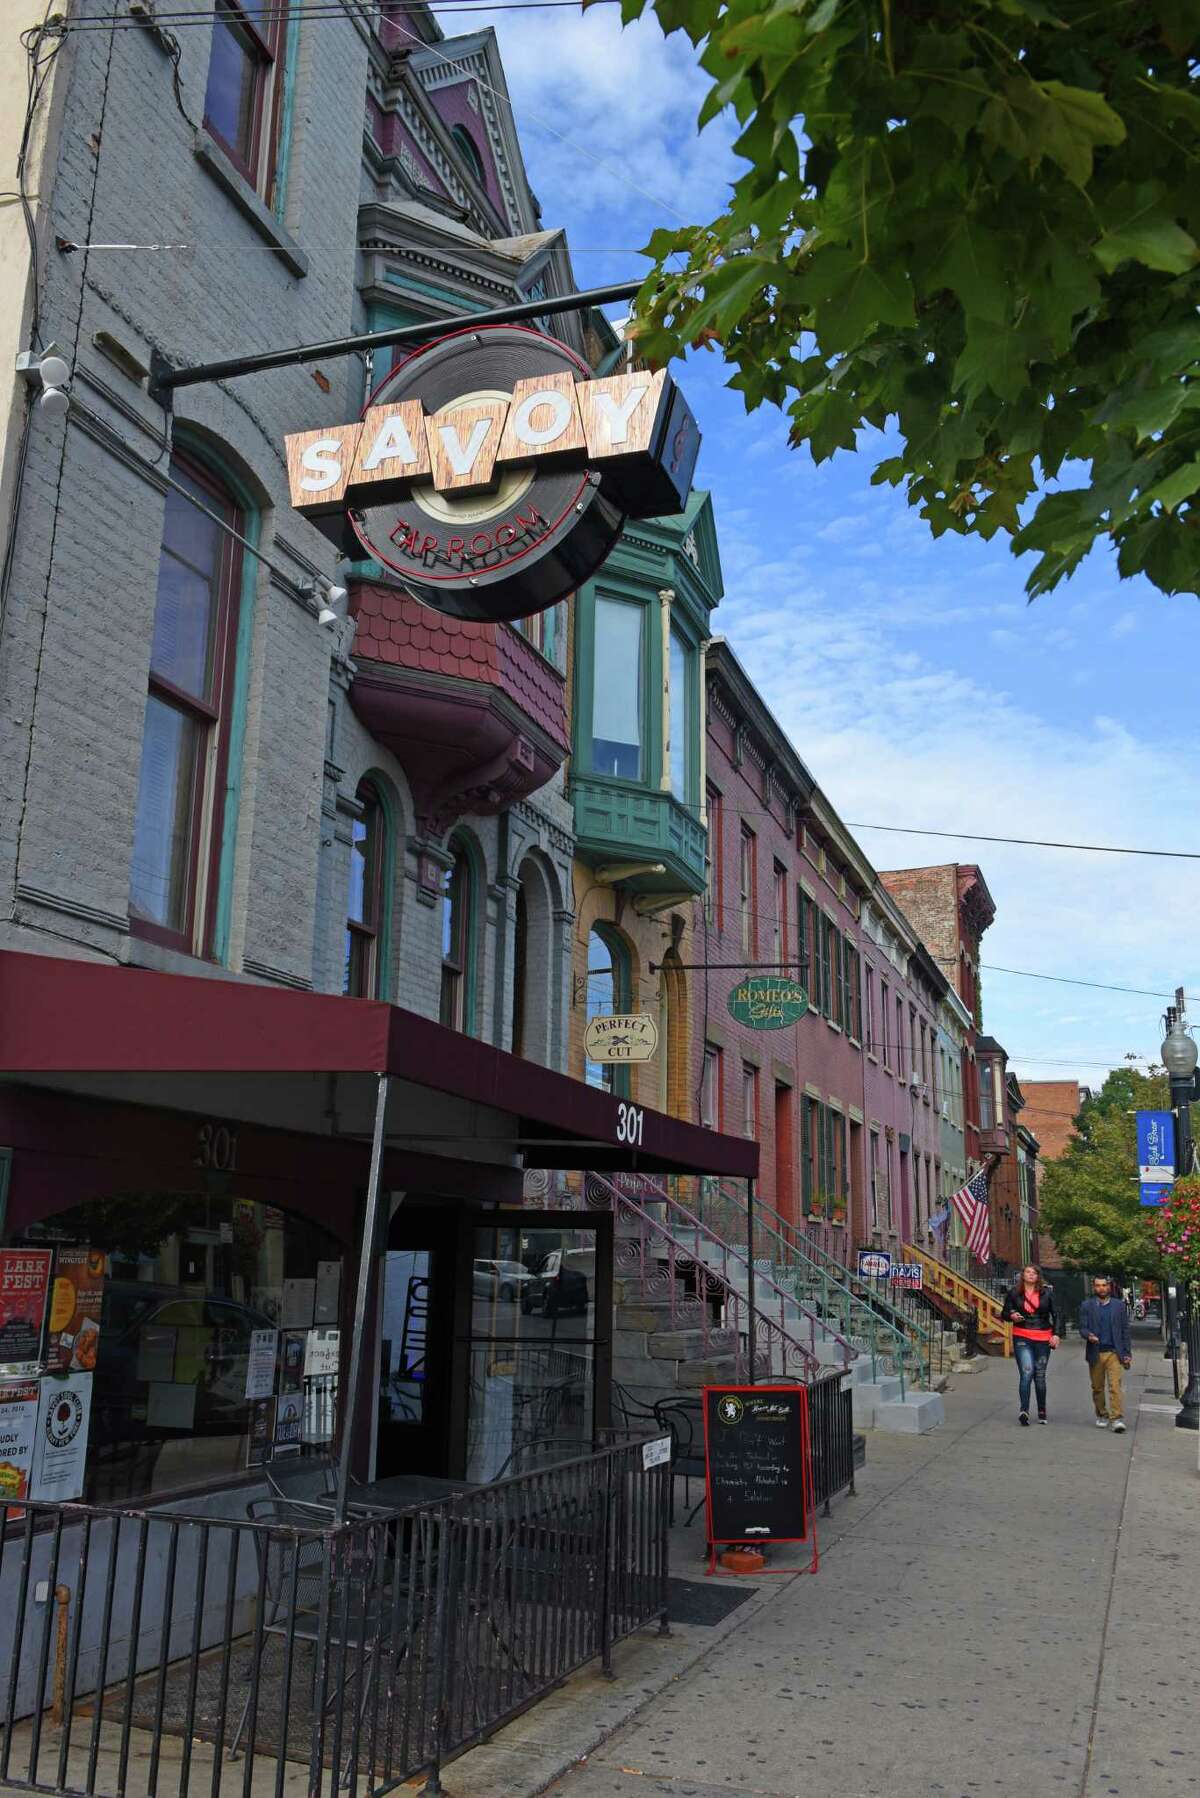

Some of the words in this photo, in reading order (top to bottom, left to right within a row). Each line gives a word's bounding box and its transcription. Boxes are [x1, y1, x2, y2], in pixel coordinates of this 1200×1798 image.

[299, 385, 650, 493] SAVOY
[389, 518, 438, 558] TAP
[447, 504, 552, 562] ROOM
[737, 988, 802, 1003] ROMEO'S
[595, 1019, 647, 1035] PERFECT
[608, 1046, 633, 1057] CUT
[616, 1103, 644, 1146] 301
[192, 1123, 240, 1171] 301
[4, 1260, 46, 1273] LARK
[892, 1266, 920, 1278] DAVIS
[3, 1275, 45, 1289] FEST
